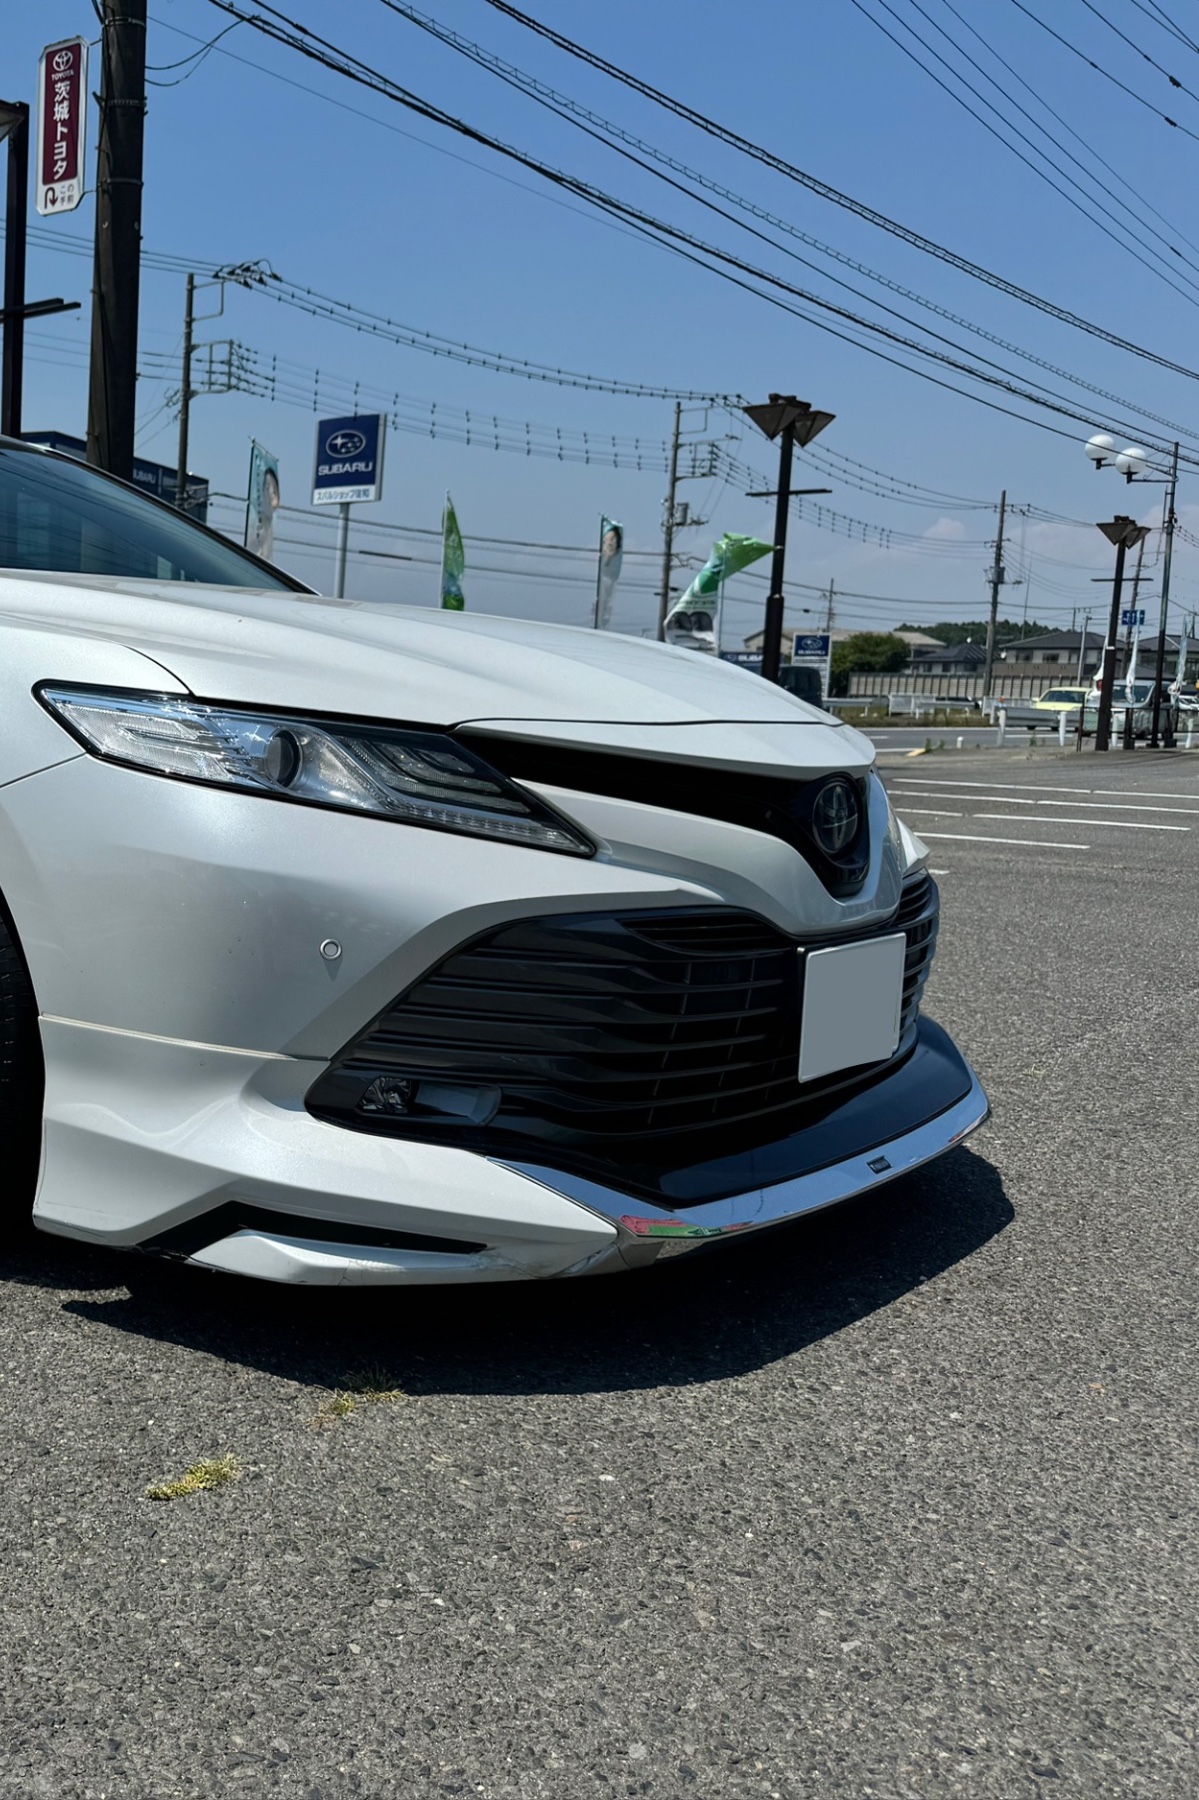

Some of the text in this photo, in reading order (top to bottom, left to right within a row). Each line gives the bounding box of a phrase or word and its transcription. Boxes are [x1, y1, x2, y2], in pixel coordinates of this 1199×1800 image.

[51, 70, 74, 81] TOYOTA
[53, 81, 71, 180] 茨城トヨタ
[317, 461, 373, 476] SUBARU
